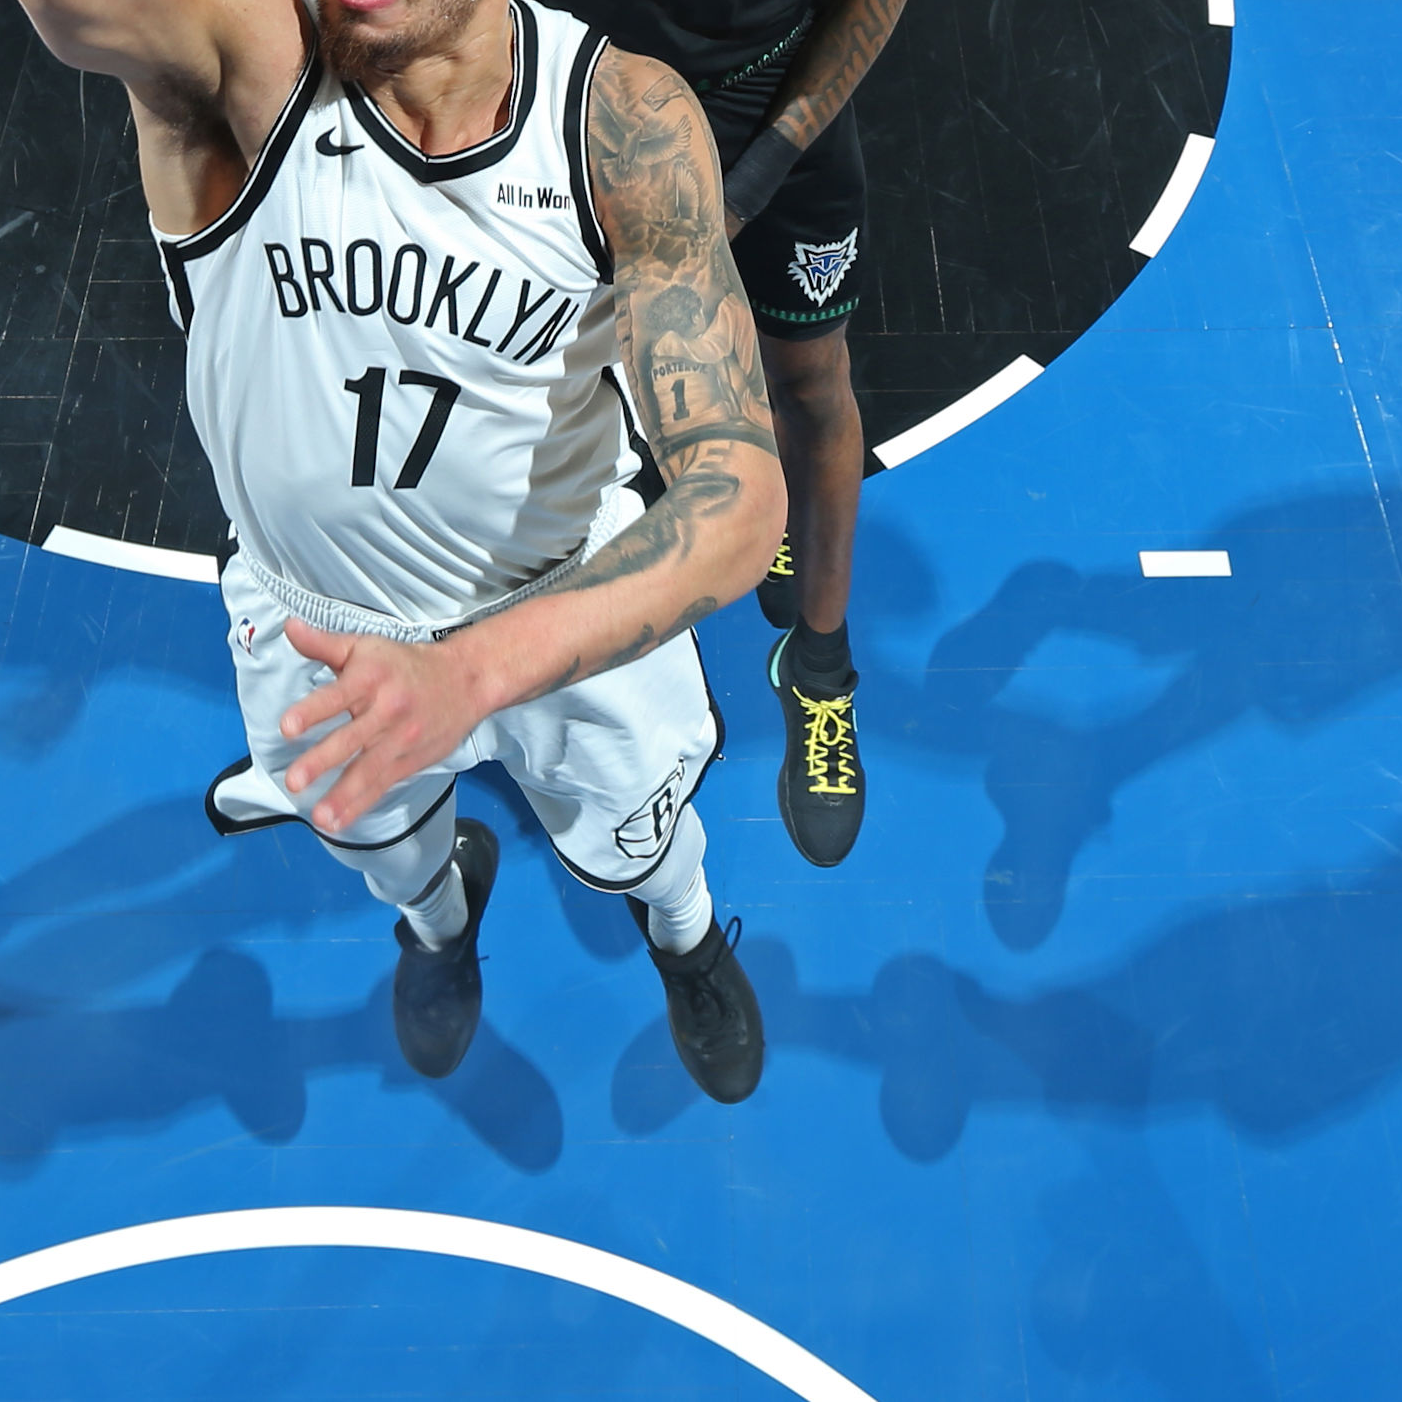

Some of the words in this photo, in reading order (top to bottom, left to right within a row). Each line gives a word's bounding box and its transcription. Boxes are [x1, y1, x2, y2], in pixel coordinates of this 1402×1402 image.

[497, 182, 515, 207] All
[518, 185, 534, 209] In
[536, 186, 572, 211] Won
[264, 237, 580, 366] BROOKLYN
[343, 366, 462, 491] 17
[670, 378, 691, 421] 1
